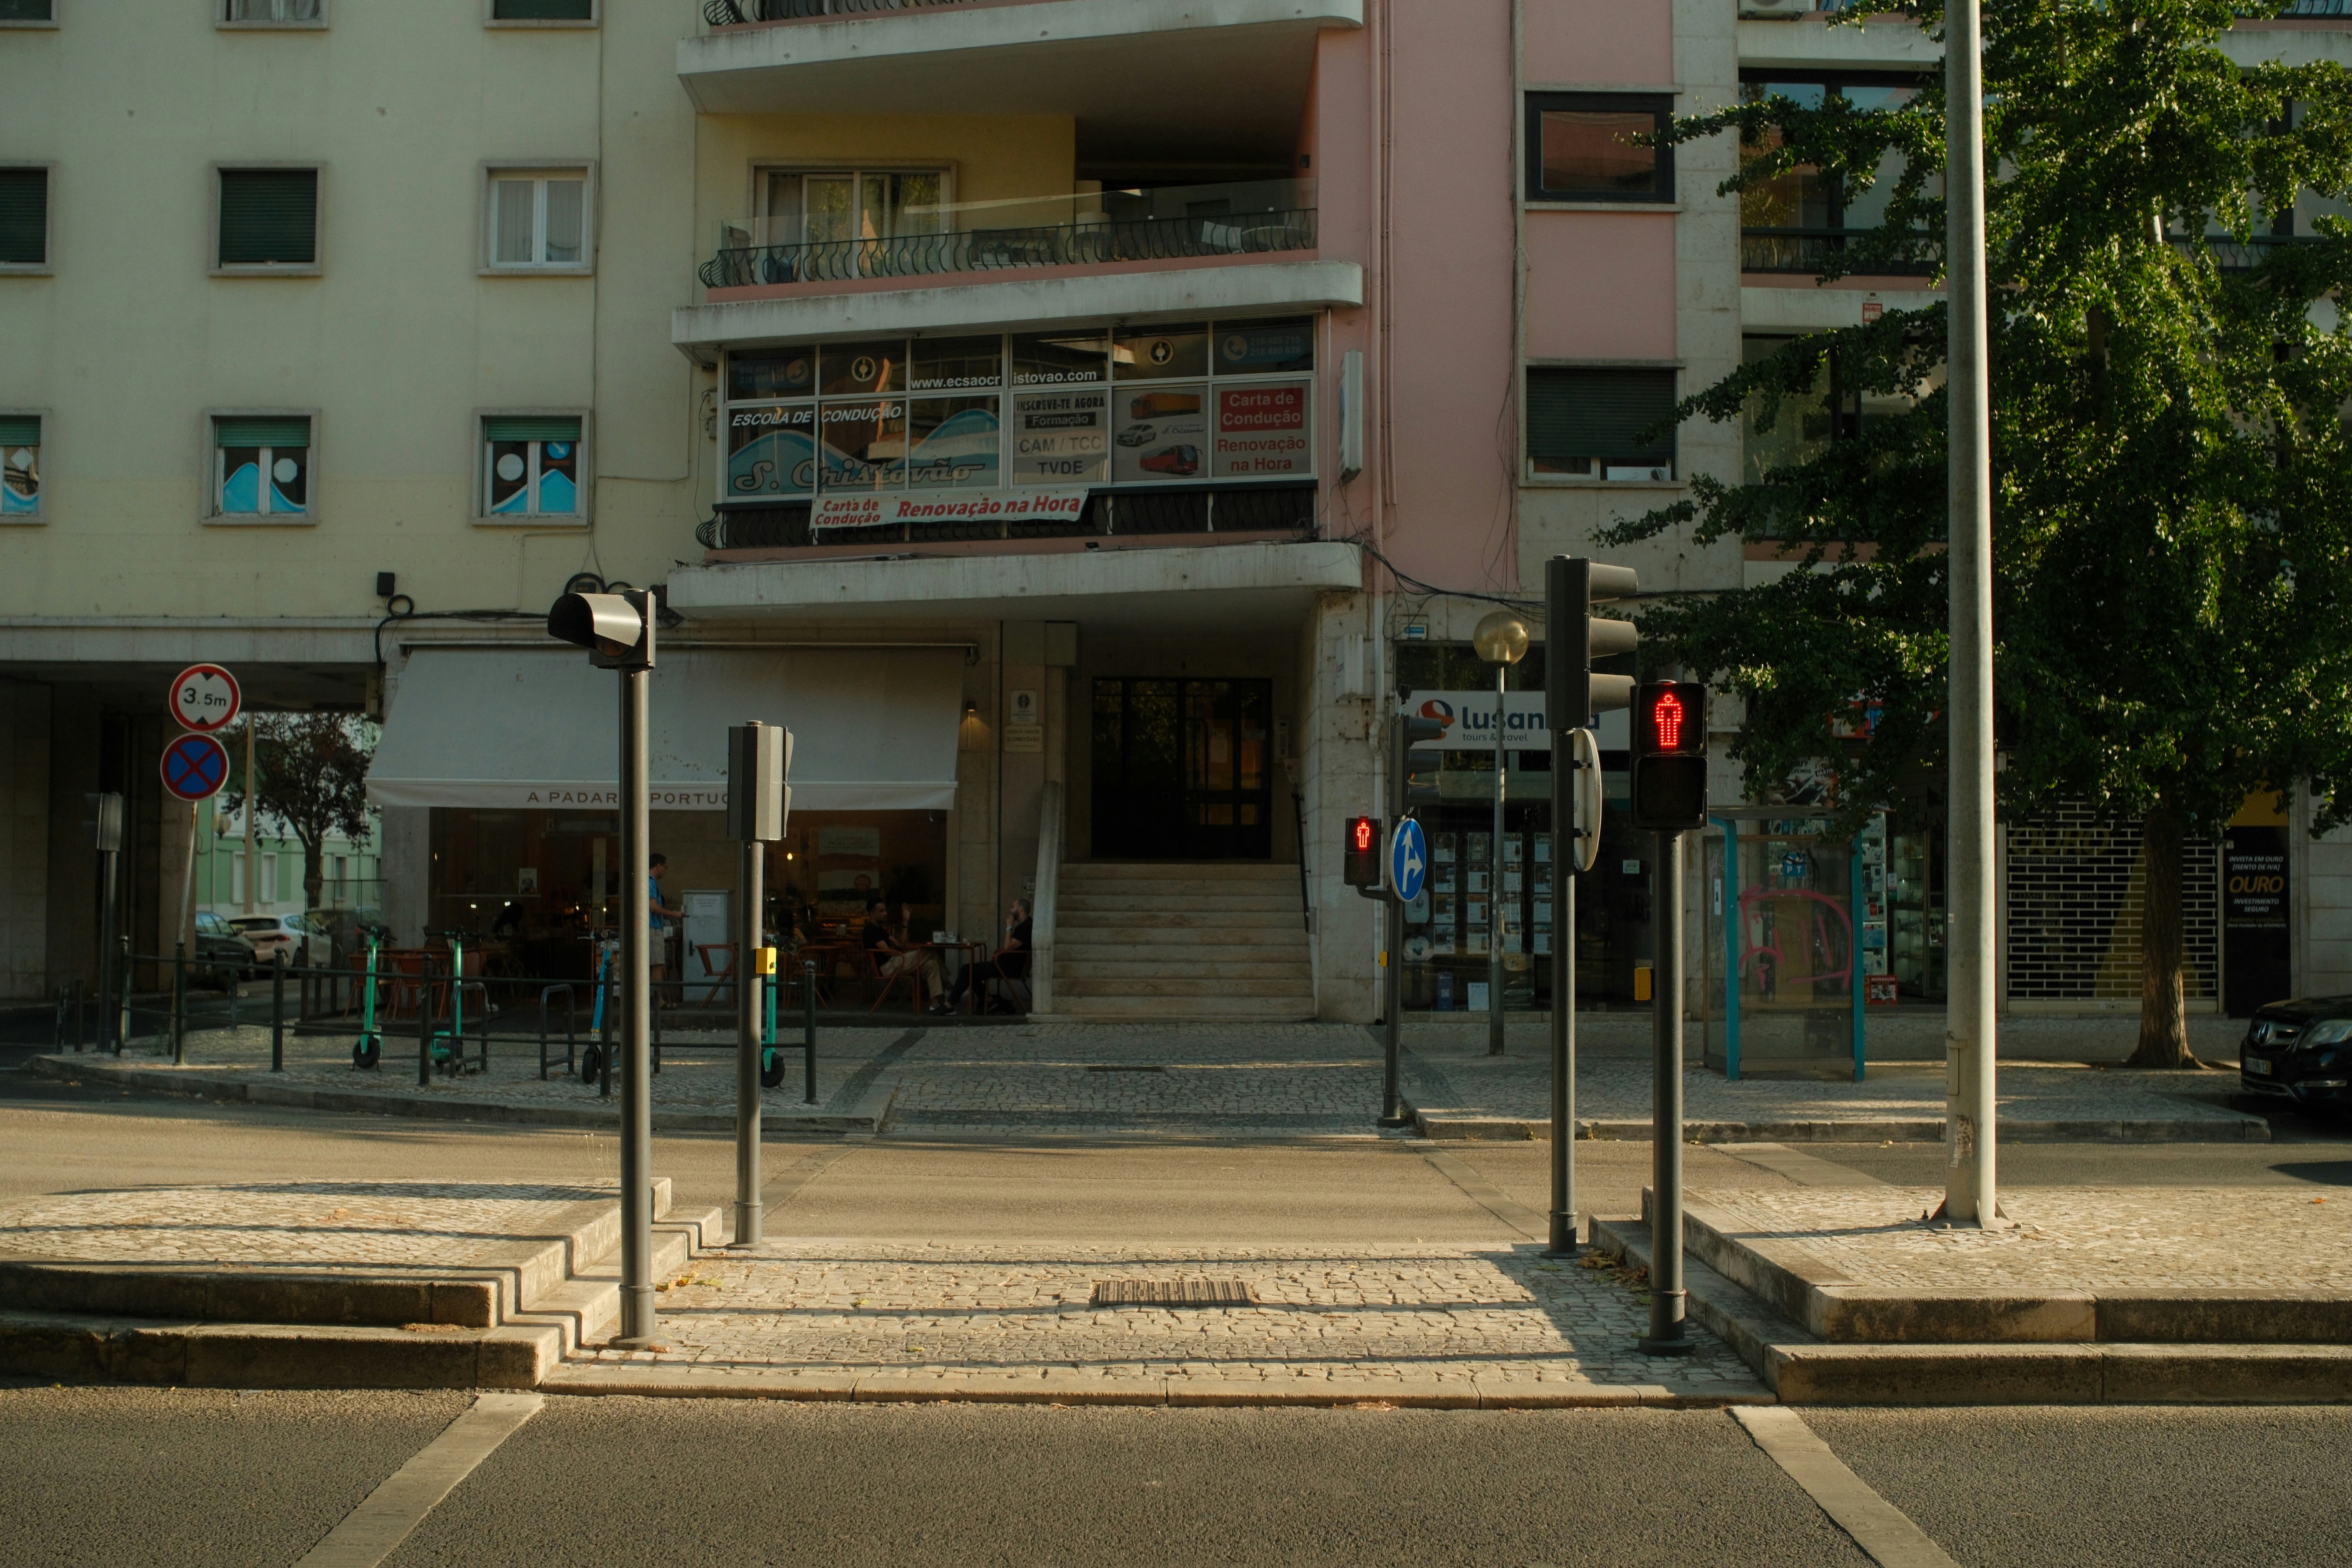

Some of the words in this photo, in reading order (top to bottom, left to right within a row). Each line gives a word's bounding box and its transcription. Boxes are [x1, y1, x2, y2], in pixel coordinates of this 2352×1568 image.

[1251, 337, 1266, 345] 218
[1285, 335, 1301, 344] 715
[1251, 347, 1266, 356] 218
[911, 370, 1097, 389] www.ecsaocristovao.com
[1017, 398, 1070, 411] INSCREVE-TE
[1074, 396, 1105, 409] AGORA
[1230, 393, 1271, 407] Carta
[1276, 392, 1294, 404] de
[732, 412, 789, 426] ESCOLA
[792, 410, 813, 423] DE
[821, 406, 902, 422] CONDUÇÃO
[1033, 414, 1089, 426] Formação
[1223, 411, 1301, 426] Condução
[1019, 438, 1055, 453] CAM
[1069, 436, 1102, 451] TCC
[1218, 436, 1306, 454] Renovação
[1038, 460, 1083, 475] TVDE
[1230, 460, 1249, 471] na
[1255, 457, 1292, 471] Hora
[734, 460, 779, 491] S.
[823, 500, 858, 512] Carta
[862, 498, 879, 511] de
[897, 497, 1001, 518] Renovação
[1004, 502, 1027, 514] na
[1033, 496, 1080, 513] Hora
[815, 512, 881, 526] Condução
[1462, 707, 1600, 729] lusana
[1463, 733, 1487, 741] tours
[1503, 732, 1528, 741] ravel
[527, 792, 540, 803] A
[549, 792, 617, 804] PADAR
[2229, 875, 2284, 894] OURO
